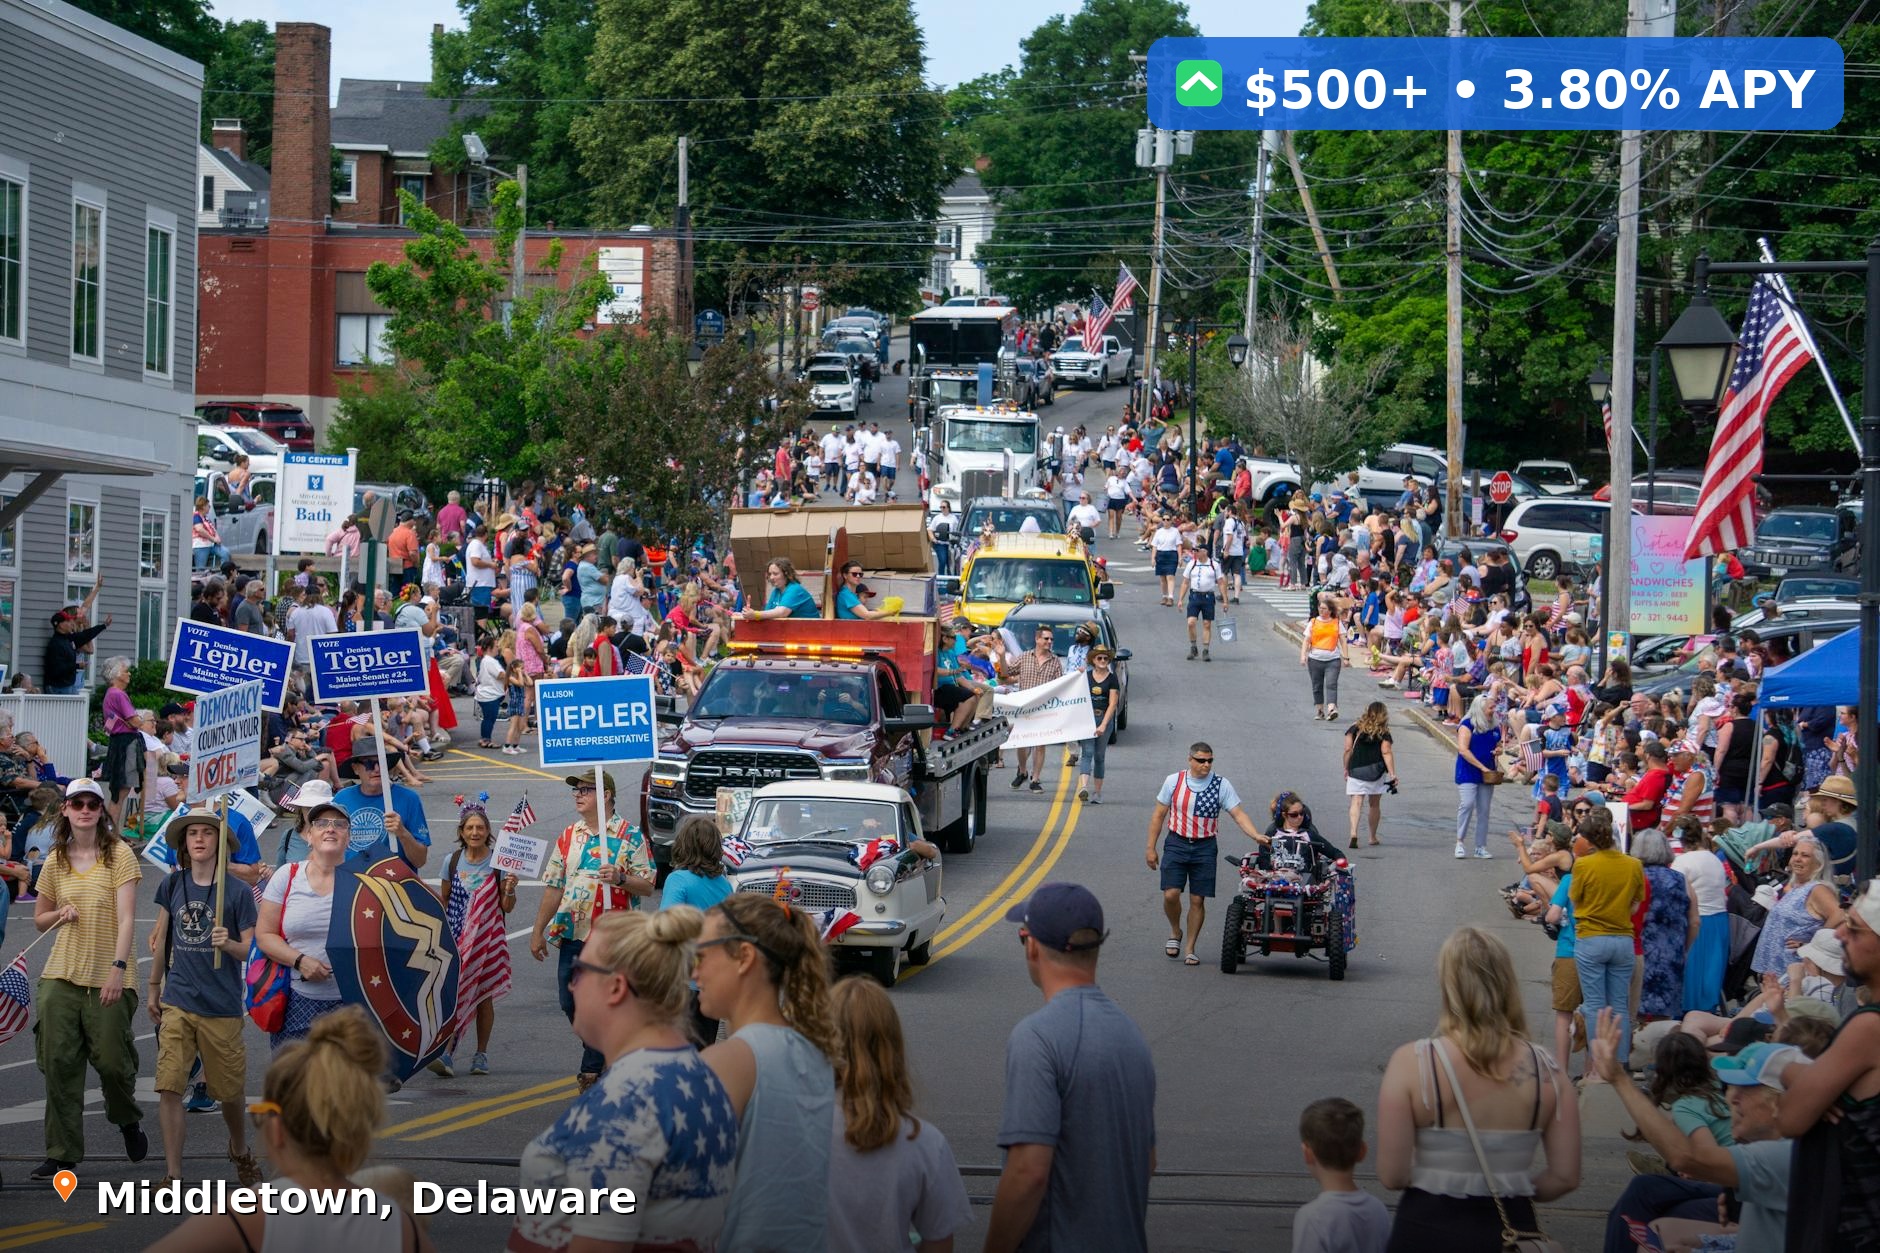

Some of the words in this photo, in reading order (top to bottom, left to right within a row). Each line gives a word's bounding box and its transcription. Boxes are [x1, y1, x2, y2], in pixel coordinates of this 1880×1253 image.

[291, 456, 306, 464] 108
[308, 456, 343, 465] CENTRE
[1492, 481, 1511, 494] STOP
[296, 507, 331, 521] Bath
[1631, 577, 1694, 587] ANDWICHES
[1631, 613, 1641, 621] 07
[187, 626, 210, 638] VOTE
[213, 641, 239, 653] Denise
[346, 646, 372, 654] Denise
[189, 639, 278, 677] Tepler
[324, 646, 412, 673] Tepler
[192, 666, 218, 679] Maine
[362, 673, 390, 681] Senate
[391, 671, 407, 679] #24
[542, 690, 574, 699] ALLISON
[200, 685, 260, 728] DEMOCRACY
[544, 702, 649, 731] HEPLER
[198, 724, 226, 752] COUNTS
[226, 721, 238, 742] ON
[239, 716, 259, 739] YOUR
[545, 738, 573, 748] STATE
[574, 733, 650, 746] REPRESENTATIVE
[196, 751, 237, 794] VOTE!
[725, 767, 782, 778] RAM
[509, 836, 537, 846] WOMEN'S
[509, 843, 533, 852] RIGHTS
[500, 846, 518, 858] COUNTS
[518, 851, 526, 860] ON
[525, 852, 539, 861] YOUR
[497, 855, 523, 870] VOTE!
